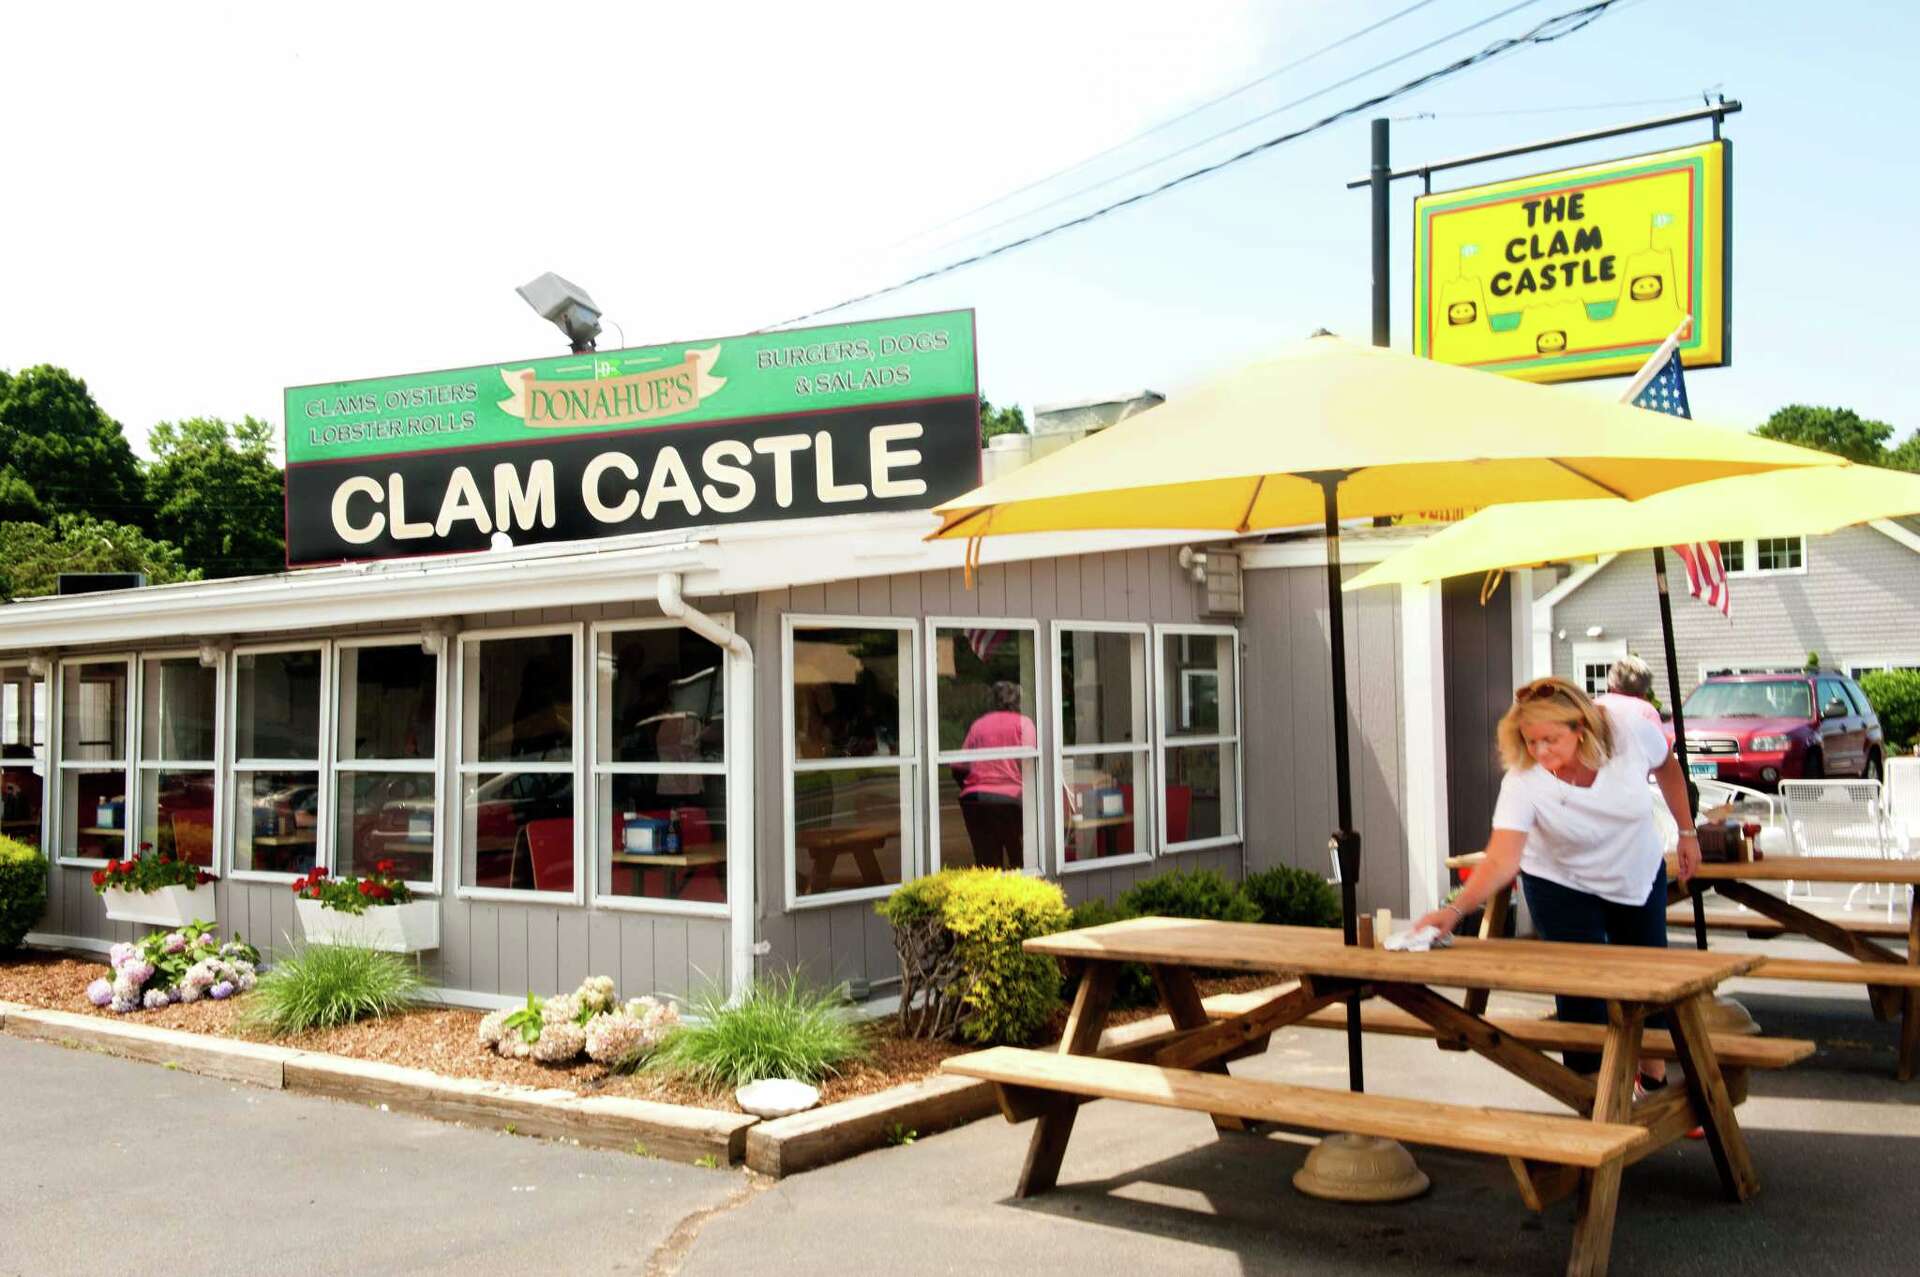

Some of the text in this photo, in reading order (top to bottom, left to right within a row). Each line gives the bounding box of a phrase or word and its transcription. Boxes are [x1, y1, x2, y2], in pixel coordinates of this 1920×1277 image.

[1521, 192, 1585, 228] THE
[1505, 226, 1603, 263] CLAM
[1490, 255, 1616, 297] CASTLE
[756, 330, 949, 370] BURGERS, DOGS
[530, 373, 693, 421] DONAHUE'S
[795, 364, 911, 397] & SALADS
[305, 383, 478, 419] CLAMS, OYSTERS
[309, 411, 476, 447] LOBSTER ROLLS
[331, 422, 927, 544] CLAM CASTLE
